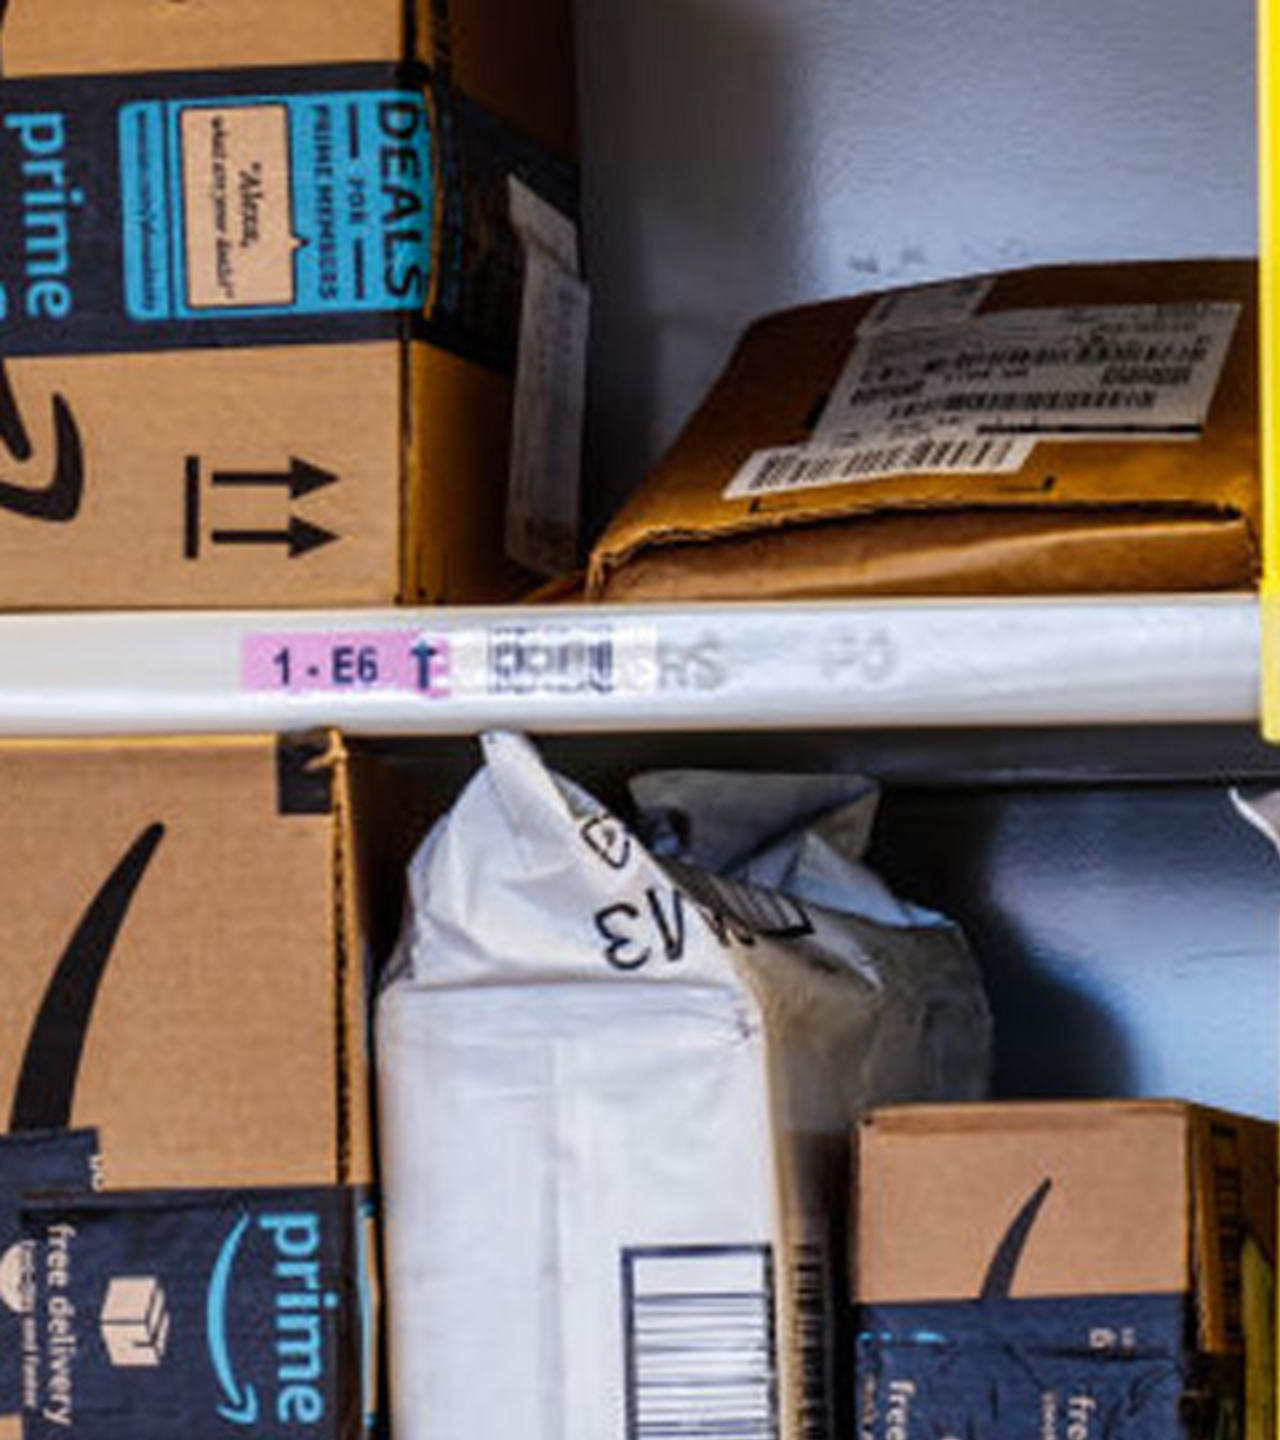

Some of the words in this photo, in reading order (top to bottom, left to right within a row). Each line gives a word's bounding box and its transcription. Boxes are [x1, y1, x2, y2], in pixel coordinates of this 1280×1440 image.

[312, 104, 334, 176] PRIME
[349, 176, 367, 225] FOR
[377, 101, 425, 298] DEALS
[4, 111, 84, 319] prime
[316, 185, 337, 300] MEMBERS
[47, 1224, 75, 1286] free
[43, 1297, 77, 1426] delivery
[259, 1213, 340, 1424] prime
